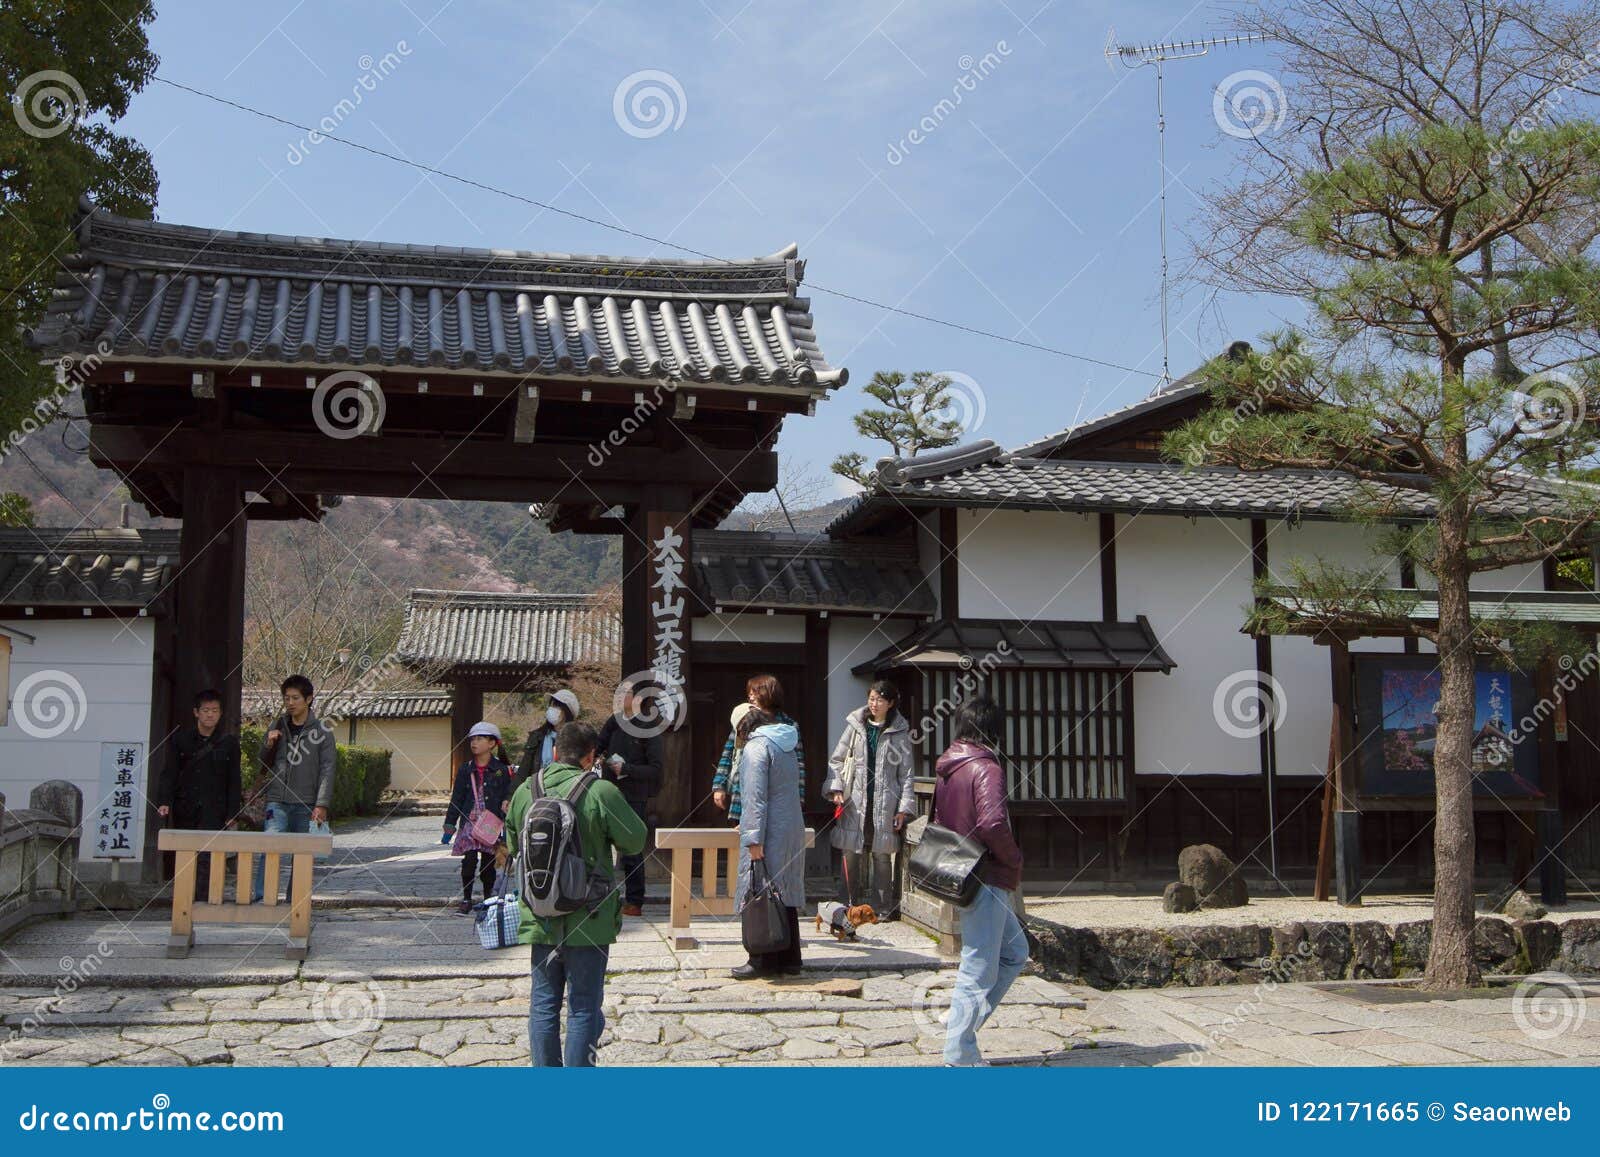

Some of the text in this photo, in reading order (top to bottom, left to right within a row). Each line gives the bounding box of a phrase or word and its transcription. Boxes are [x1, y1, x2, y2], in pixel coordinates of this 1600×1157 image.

[651, 526, 686, 722] 大本山天龍寺
[110, 748, 136, 850] 諸車通行止
